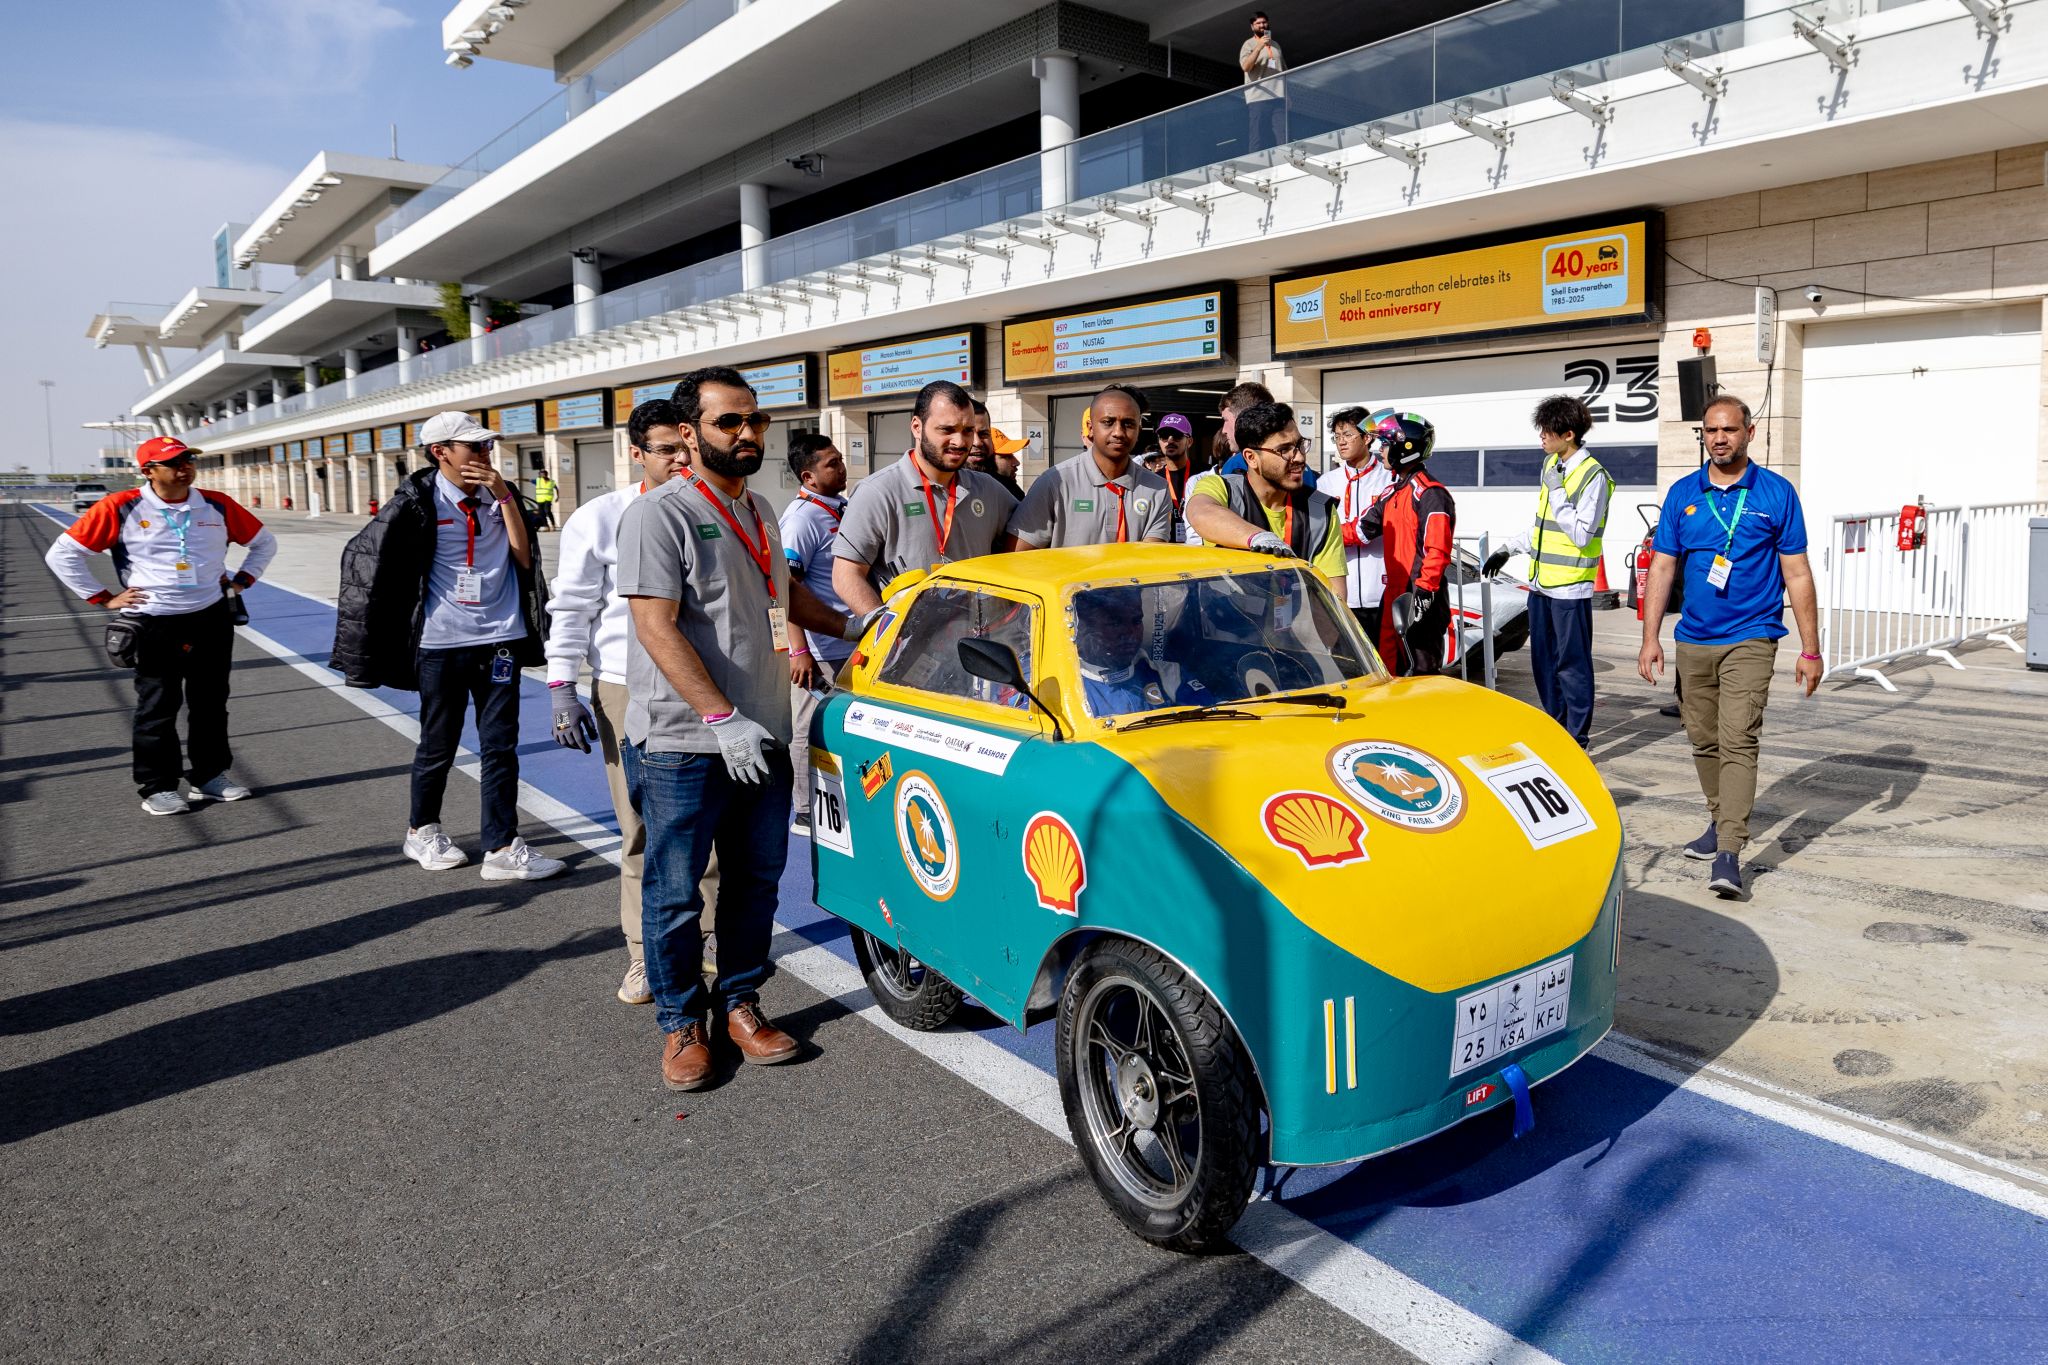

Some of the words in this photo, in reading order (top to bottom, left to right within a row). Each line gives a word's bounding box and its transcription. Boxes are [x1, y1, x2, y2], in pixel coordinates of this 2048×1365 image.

[1551, 250, 1584, 278] 40
[1585, 260, 1618, 278] years
[1339, 289, 1362, 305] Shell
[1364, 282, 1435, 302] Eco-marathon
[1438, 274, 1495, 292] celebrates
[1498, 269, 1511, 283] its
[1551, 286, 1566, 296] Shell
[1568, 281, 1613, 294] Eco-marathon
[1295, 300, 1319, 314] 2025
[1339, 306, 1366, 323] 40th
[1368, 300, 1442, 320] anniversary
[1082, 320, 1096, 329] Team
[1097, 318, 1114, 327] Urban
[1012, 344, 1048, 356] Eco-marathon
[1082, 337, 1105, 348] NUSTAG
[1082, 358, 1089, 366] EE
[1564, 355, 1659, 422] 23
[1300, 415, 1313, 426] 23
[1029, 430, 1041, 439] 24
[944, 736, 965, 749] QATAR
[977, 746, 1008, 760] SEASHORE
[1381, 808, 1401, 821] KING
[1407, 816, 1435, 825] FAISAL
[1435, 793, 1460, 821] UNIVERSITY
[1415, 800, 1432, 809] KFU
[1505, 777, 1570, 824] 716
[814, 787, 842, 834] 716
[879, 898, 891, 919] LIFT
[1536, 1002, 1564, 1031] KFU
[1500, 1027, 1525, 1051] KSA
[1463, 1037, 1485, 1064] 25
[1467, 1086, 1488, 1105] LIFT
